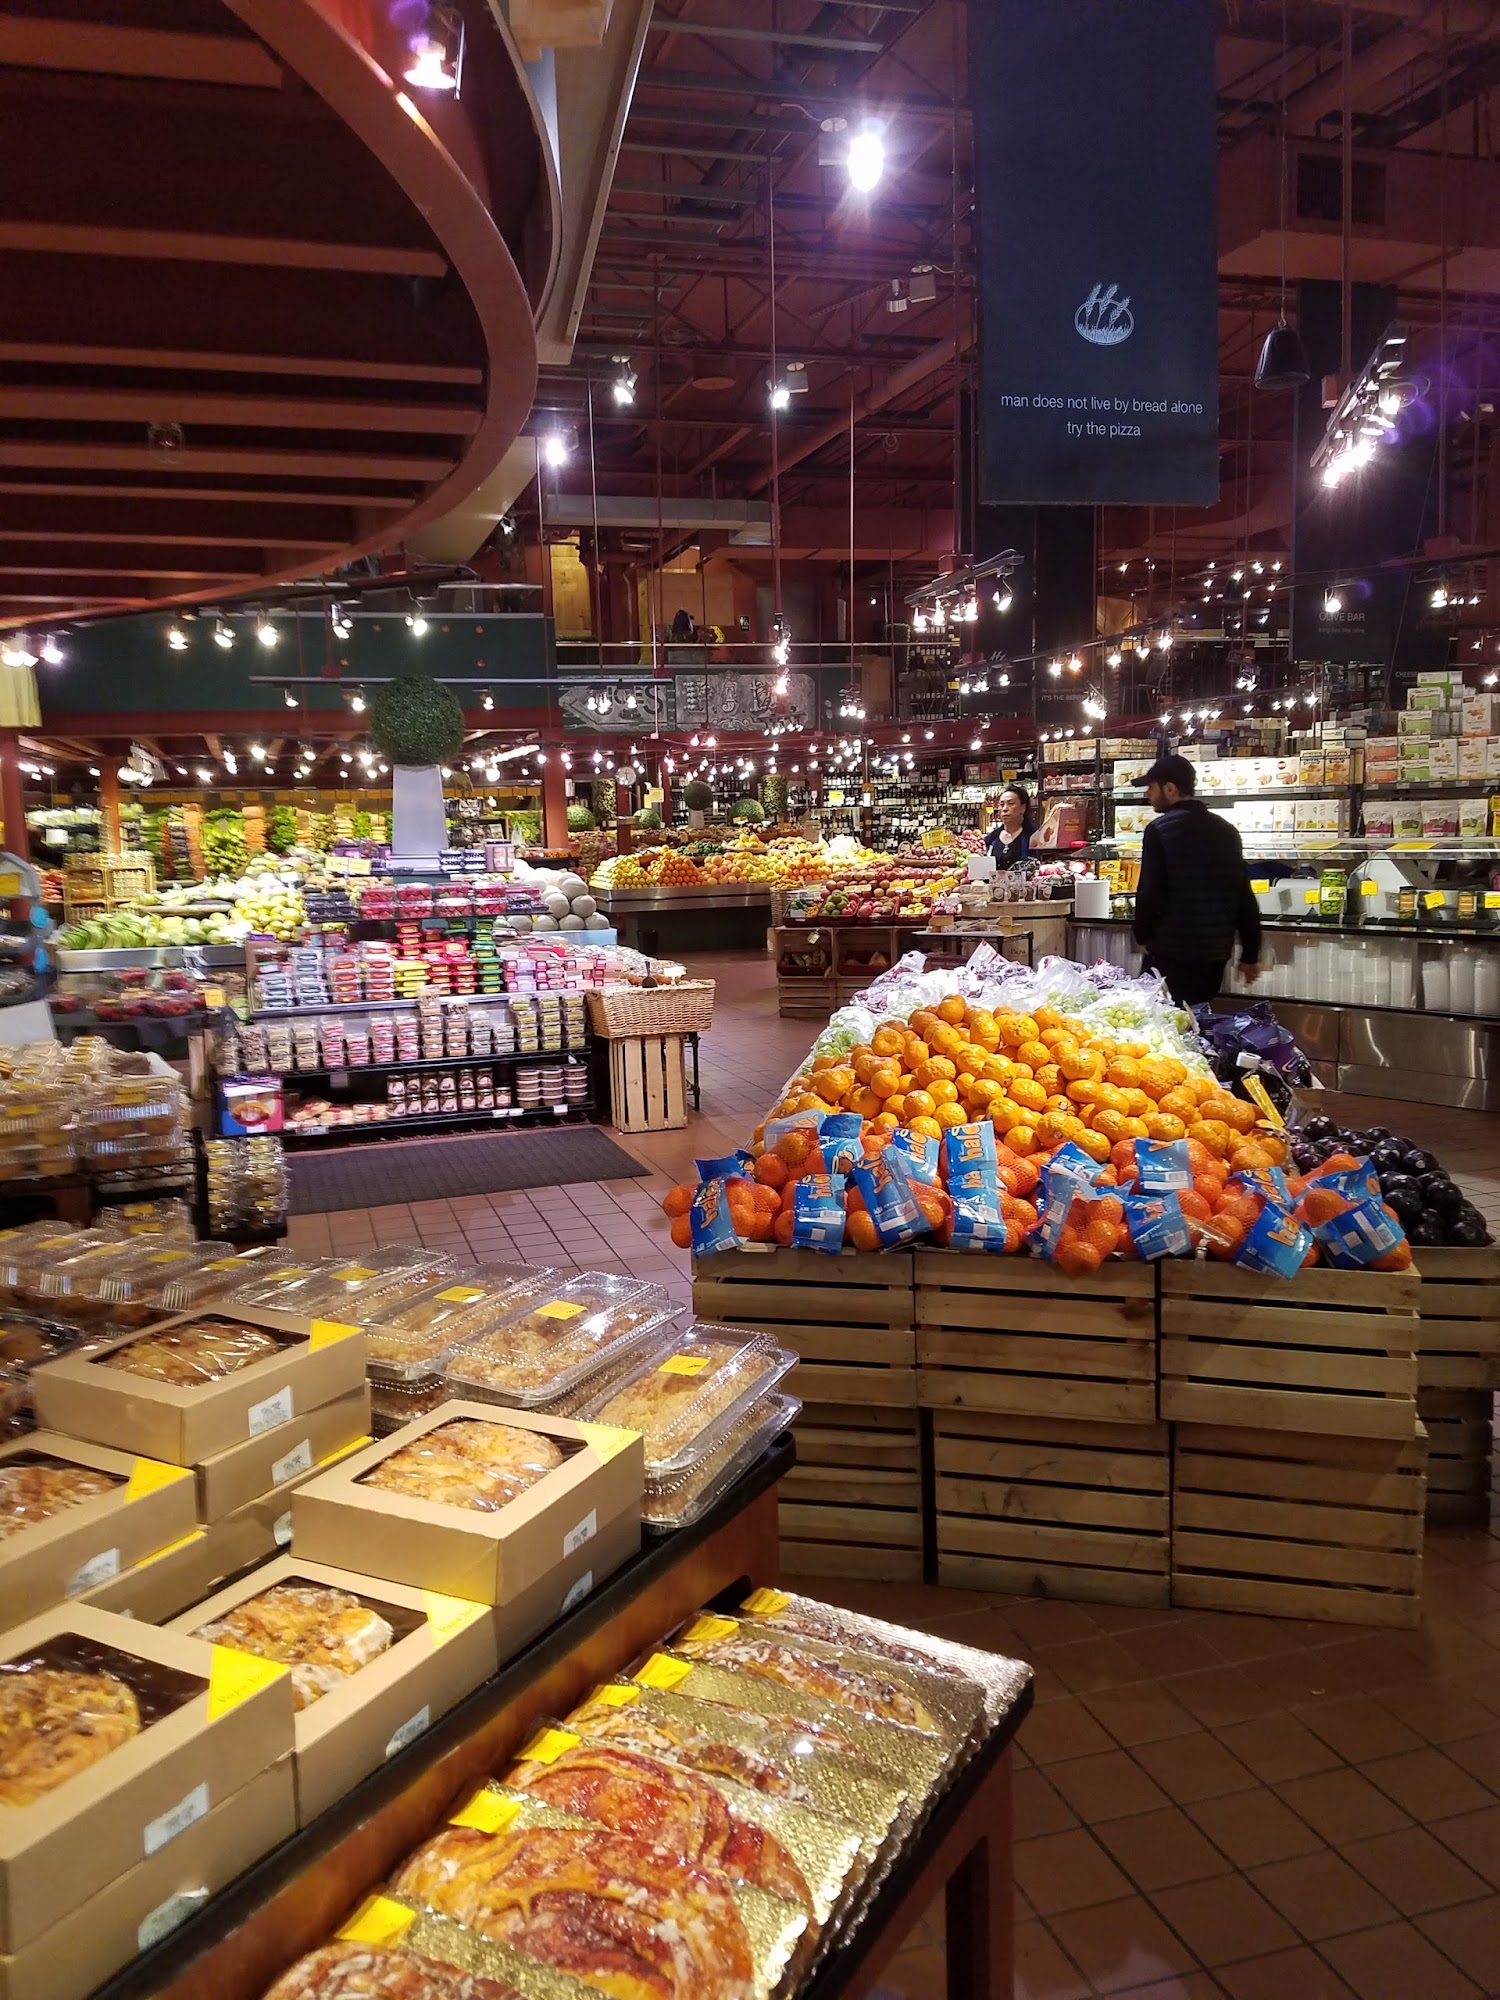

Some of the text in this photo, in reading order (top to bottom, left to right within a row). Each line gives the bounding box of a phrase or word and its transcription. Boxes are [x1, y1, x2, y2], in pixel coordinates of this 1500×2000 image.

[1001, 393, 1203, 414] man does not live by bread alone
[1066, 421, 1142, 438] try the pizza
[1319, 611, 1366, 622] OLIVE BAR
